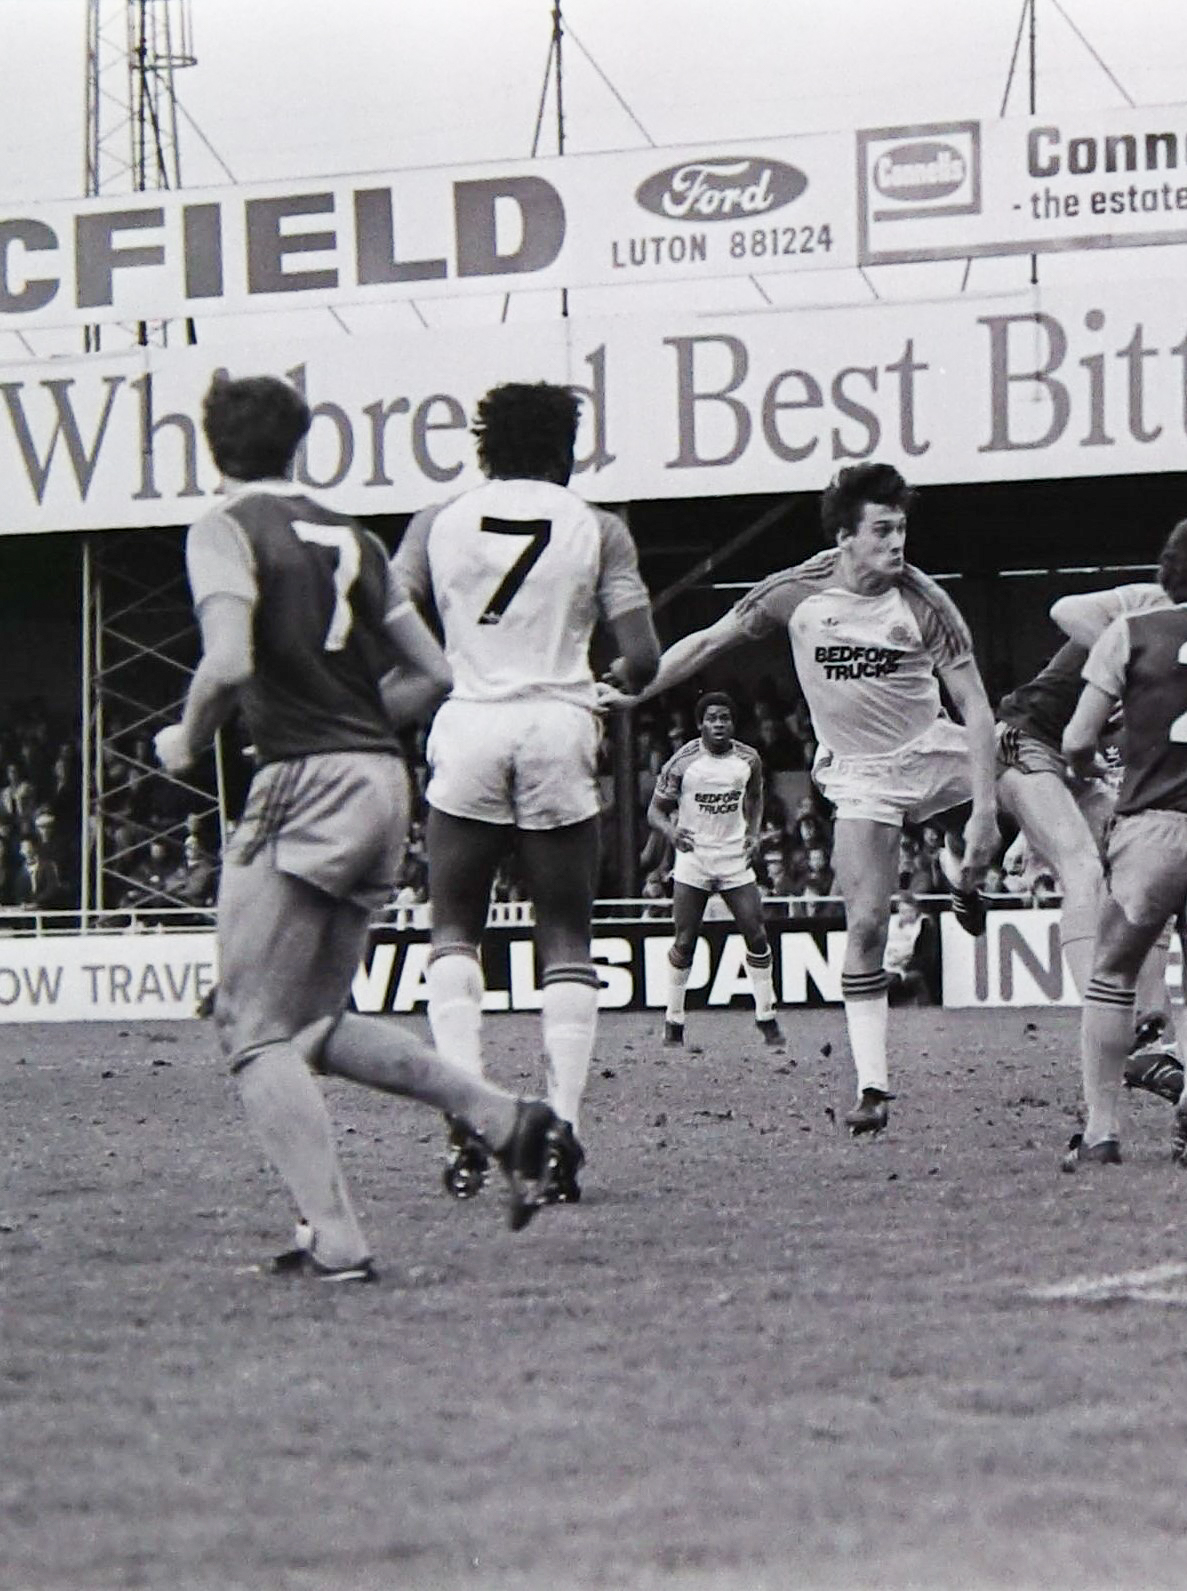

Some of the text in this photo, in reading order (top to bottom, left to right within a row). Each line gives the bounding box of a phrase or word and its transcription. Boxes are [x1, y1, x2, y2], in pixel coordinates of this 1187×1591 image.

[0, 176, 567, 313] CFIELD
[612, 224, 833, 269] LUTON 881224
[661, 161, 774, 217] Ford
[0, 342, 616, 504] Whbred
[662, 333, 931, 469] Best
[291, 519, 361, 651] 7
[477, 516, 552, 625] 7
